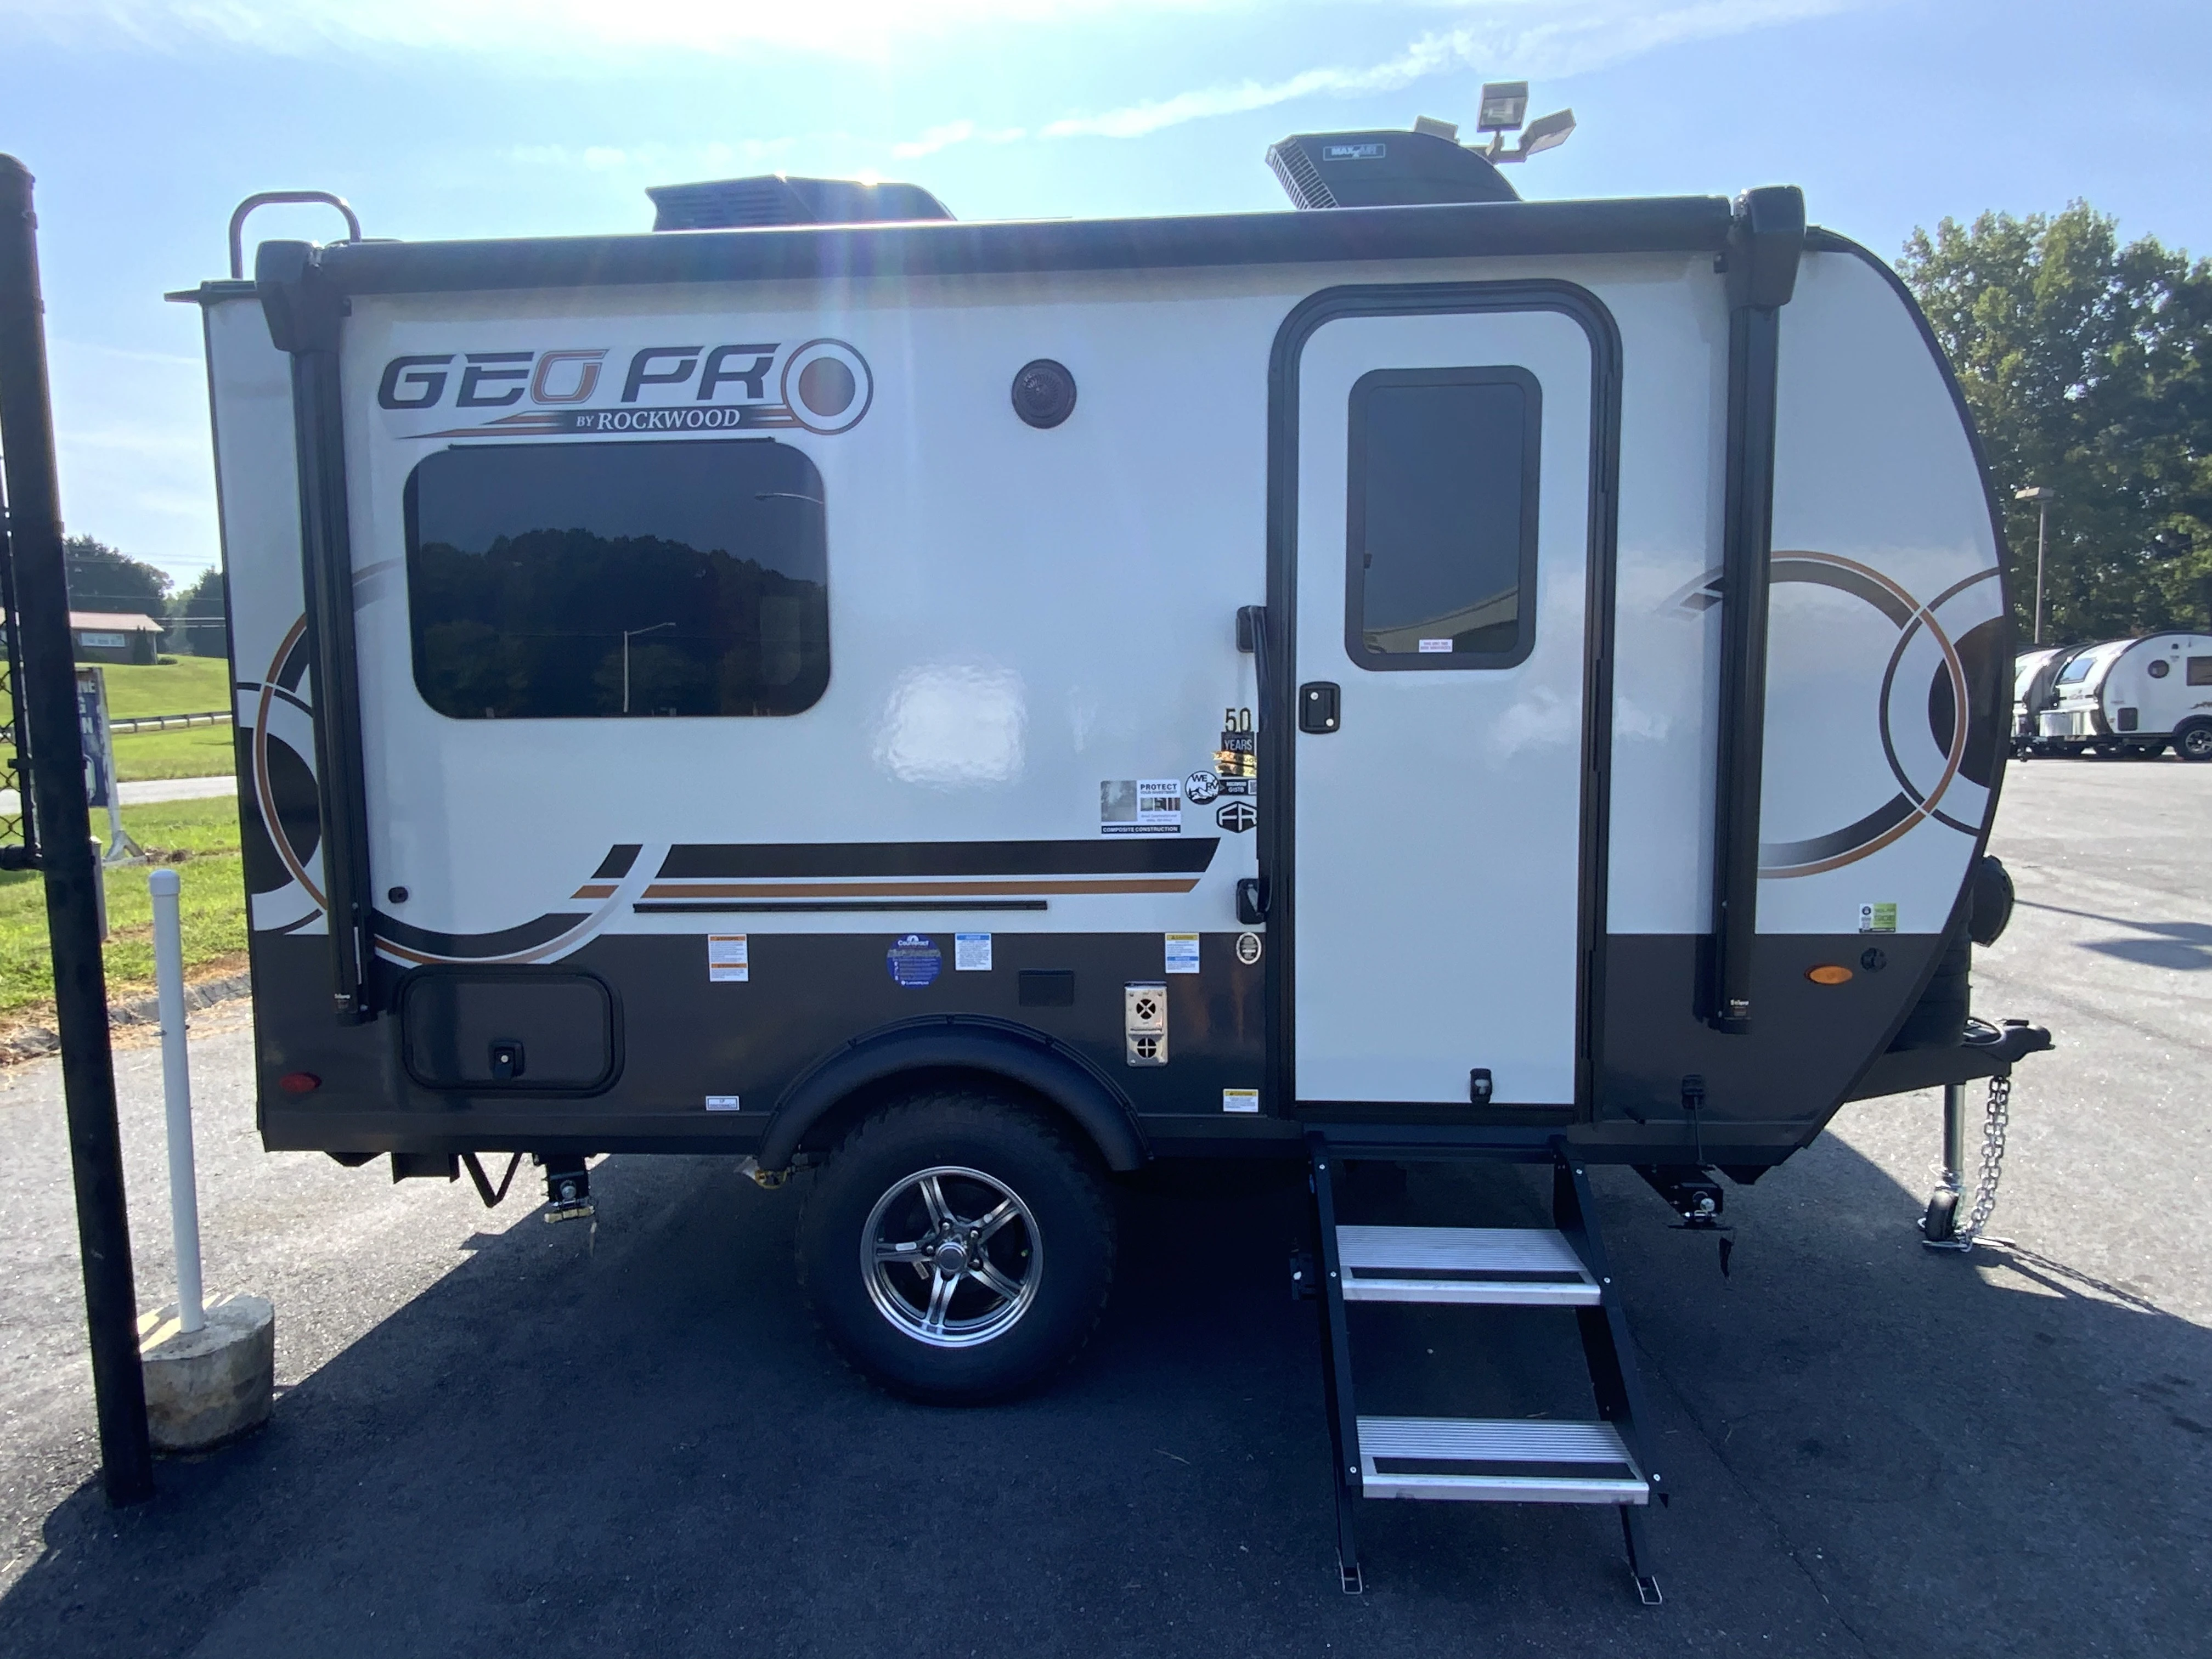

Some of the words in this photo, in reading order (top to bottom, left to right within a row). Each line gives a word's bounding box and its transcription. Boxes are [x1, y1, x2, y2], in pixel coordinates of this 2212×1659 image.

[377, 348, 610, 410] GEO
[576, 416, 594, 427] BY
[596, 409, 741, 431] ROCKWOOD
[1224, 708, 1251, 732] 50
[1224, 740, 1252, 751] YEARS
